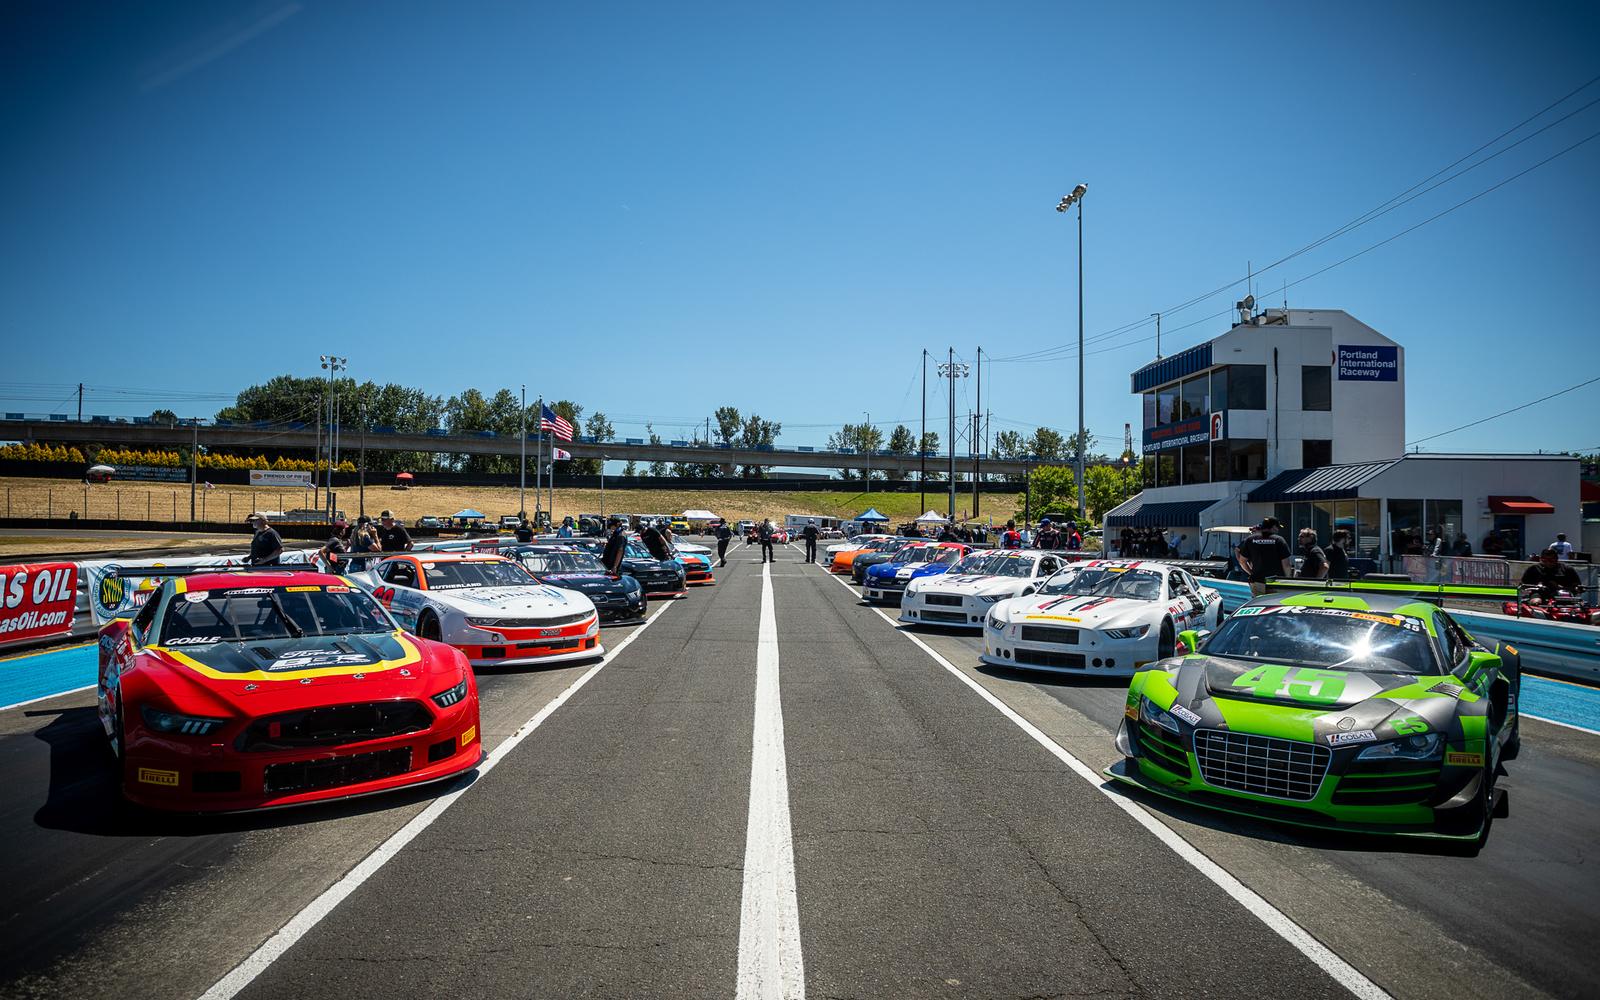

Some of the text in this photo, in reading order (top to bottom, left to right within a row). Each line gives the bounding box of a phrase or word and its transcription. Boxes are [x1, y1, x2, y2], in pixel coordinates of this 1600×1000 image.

[1340, 351, 1378, 359] Portland
[1340, 359, 1396, 368] International
[1340, 368, 1381, 378] Raceway
[1143, 432, 1209, 452] PORTLAND INTERNATIONAL RACEWAY
[32, 568, 72, 605] OIL
[429, 582, 482, 590] SUTHERLAND
[0, 611, 68, 634] asOil.com
[1403, 622, 1420, 632] 45
[165, 636, 222, 646] GOBLE
[279, 649, 342, 659] Ford
[1232, 664, 1349, 705] 45
[1340, 731, 1373, 741] COBALT
[141, 770, 178, 784] PIRELLI
